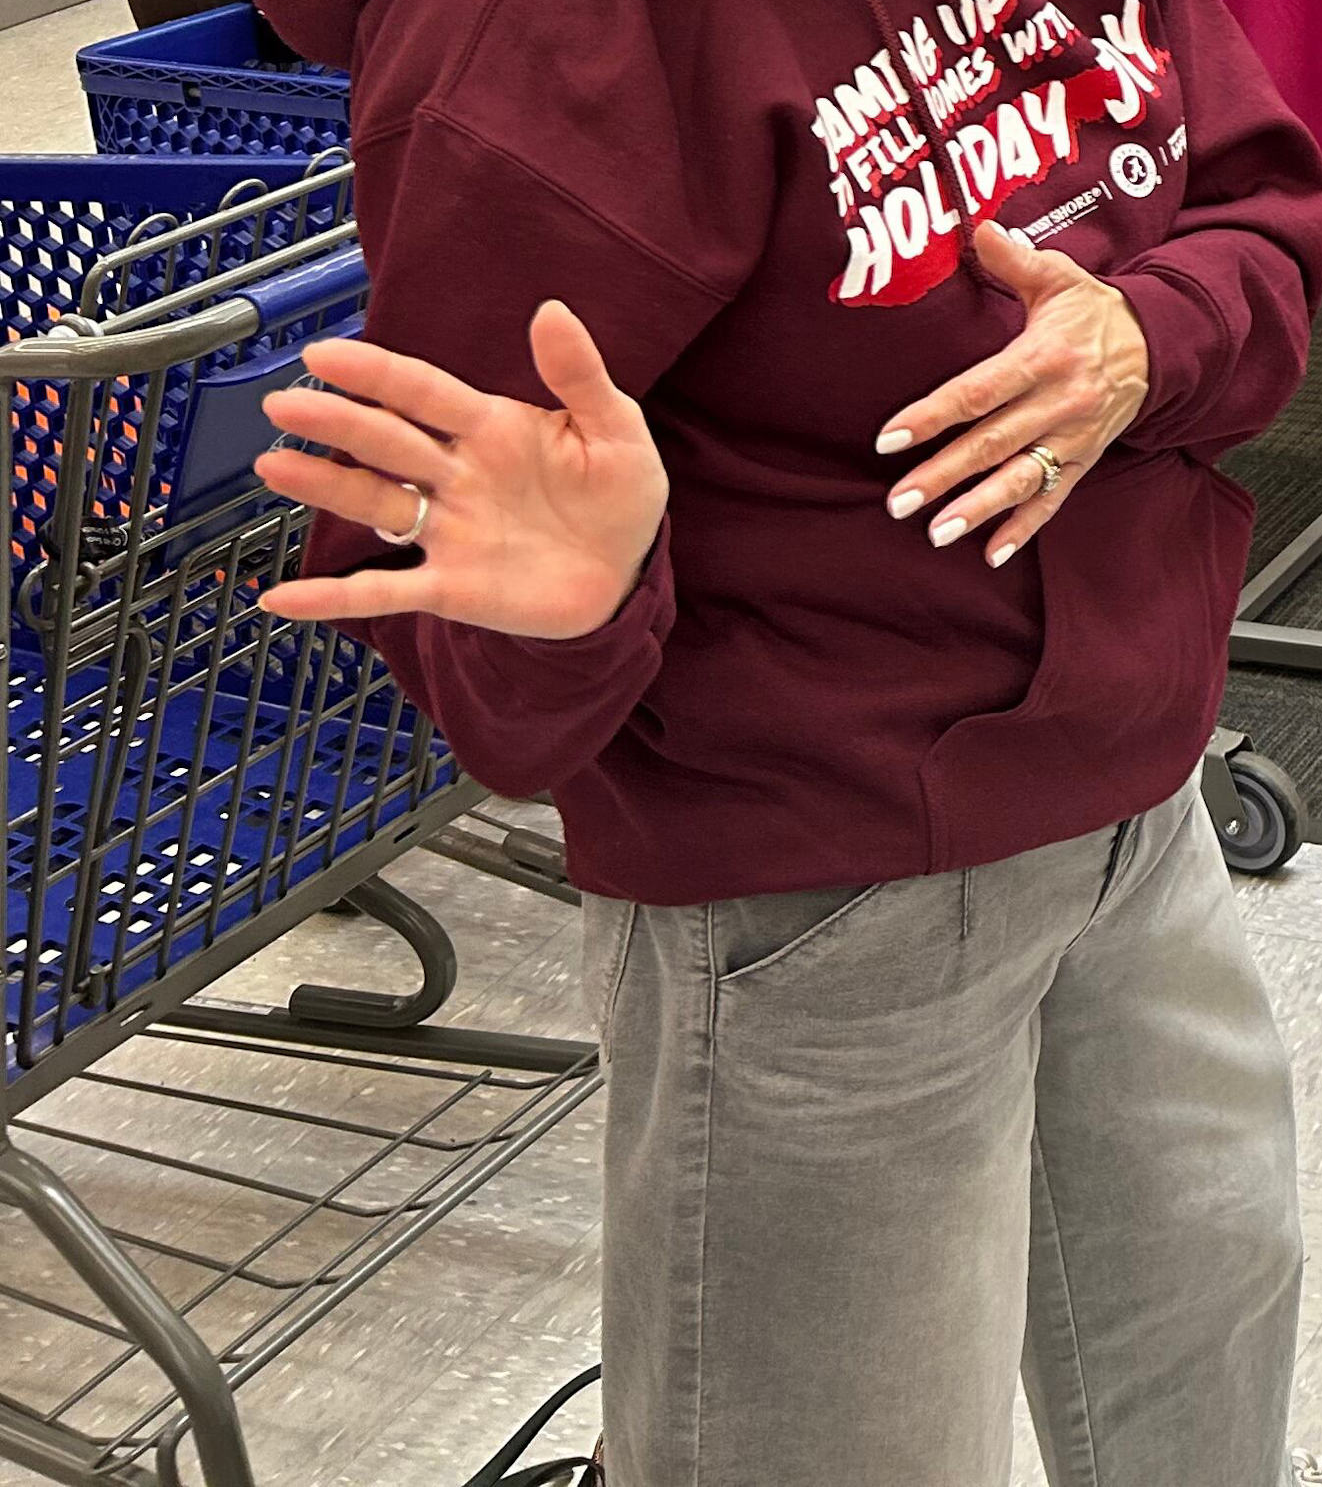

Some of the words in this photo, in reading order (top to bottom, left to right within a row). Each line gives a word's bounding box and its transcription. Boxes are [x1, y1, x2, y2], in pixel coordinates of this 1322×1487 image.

[838, 80, 1072, 299] HOLIDAY
[846, 116, 928, 193] FILL
[1048, 189, 1094, 227] SHORE
